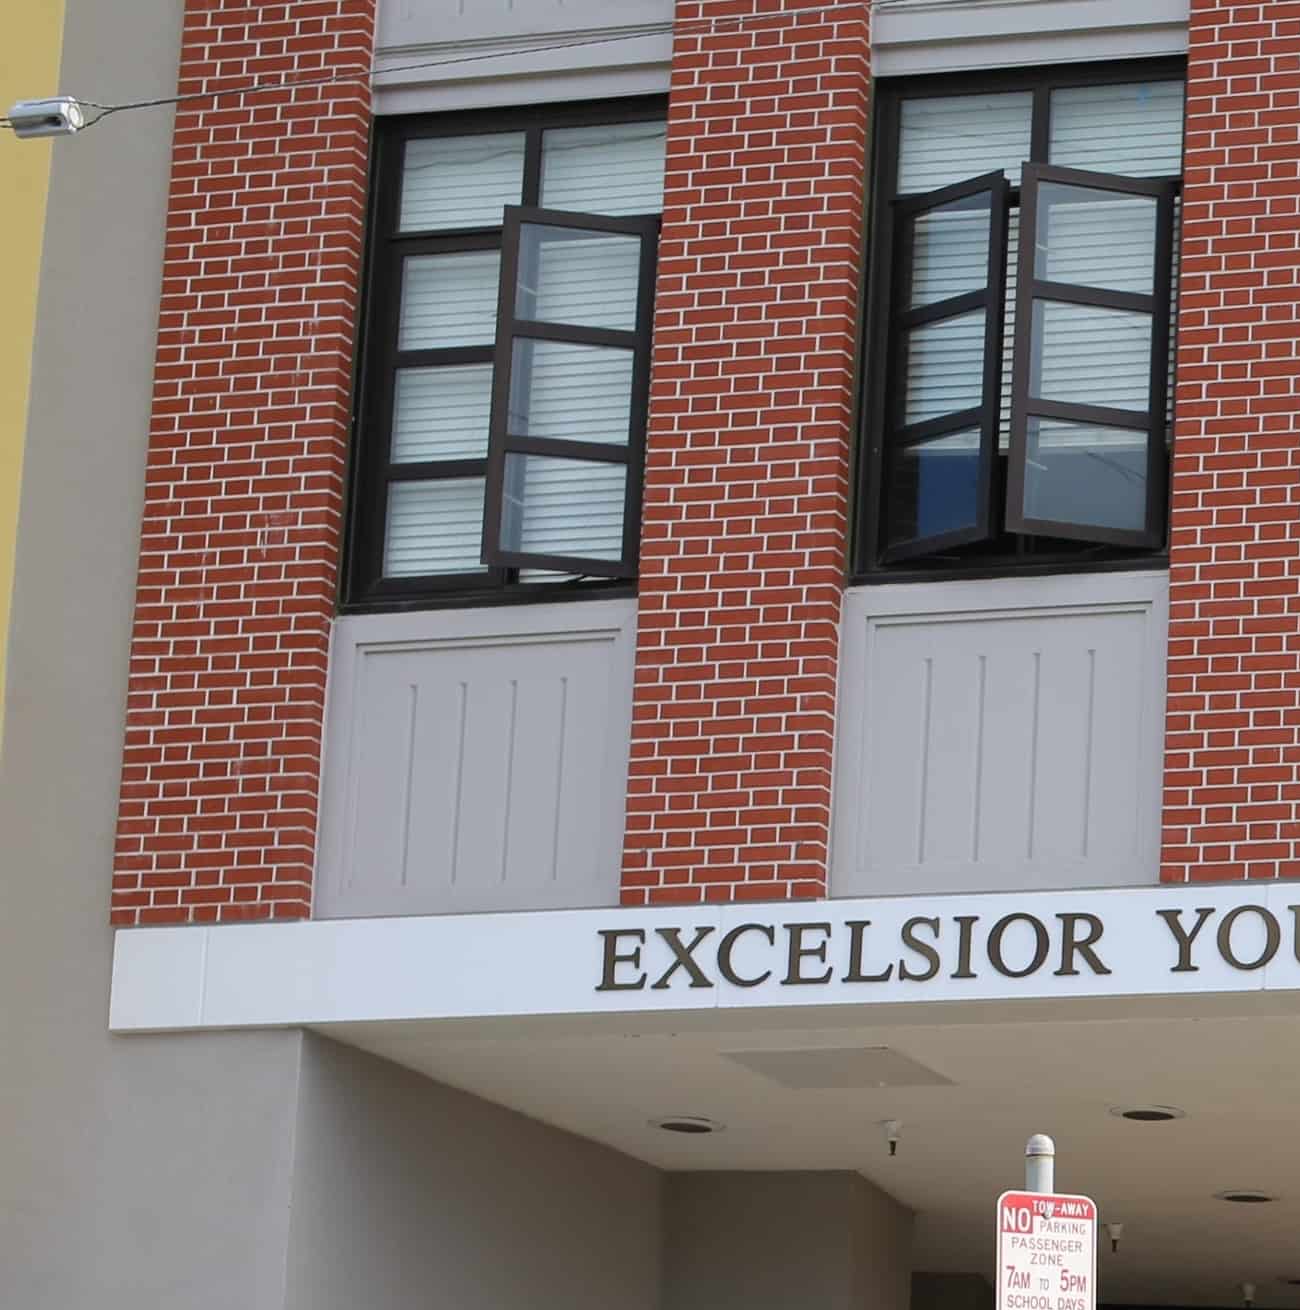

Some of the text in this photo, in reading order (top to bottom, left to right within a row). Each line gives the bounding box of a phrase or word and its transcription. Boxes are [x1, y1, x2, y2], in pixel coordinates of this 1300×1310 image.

[595, 913, 1111, 991] EXCELSIOR
[1032, 1200, 1089, 1216] TOW-AWAY
[1003, 1207, 1031, 1231] NO
[1040, 1221, 1086, 1235] PARKING
[1011, 1237, 1082, 1252] PASSENGER
[1030, 1253, 1063, 1266] ZONE
[1006, 1265, 1086, 1292] 7AM TO 5PM
[1007, 1295, 1053, 1310] SCHOOL
